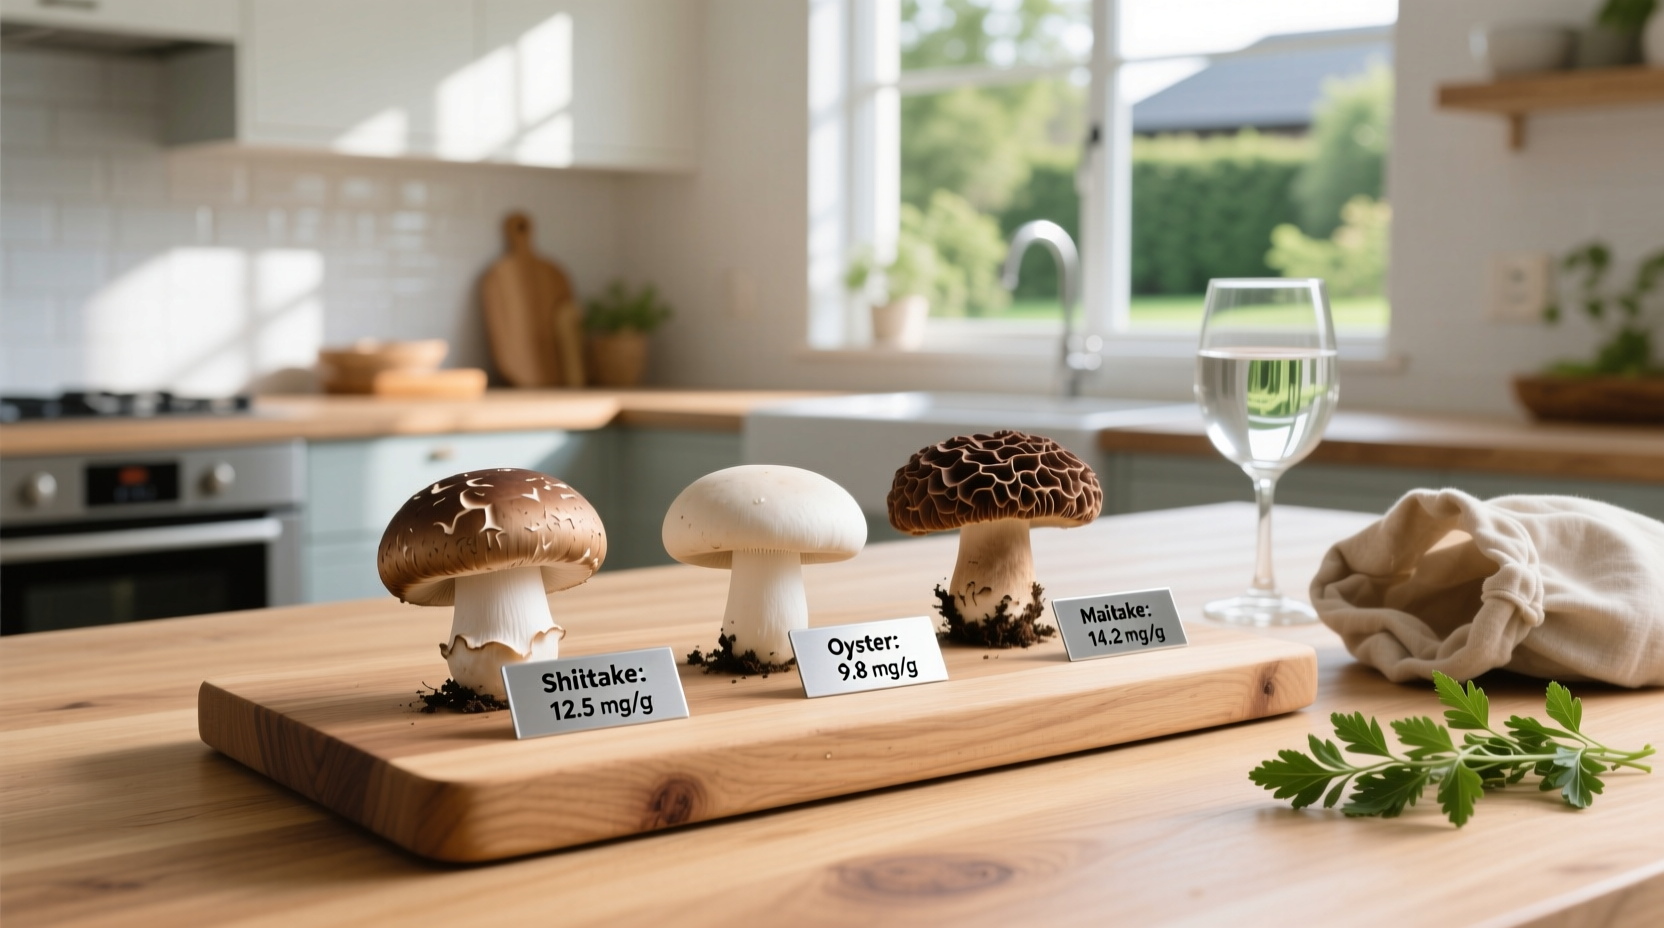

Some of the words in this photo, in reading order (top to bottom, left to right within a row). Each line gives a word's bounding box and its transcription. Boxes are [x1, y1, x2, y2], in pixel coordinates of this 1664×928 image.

[1079, 601, 1152, 625] Maitake:
[827, 635, 900, 661] Oyster:
[1088, 627, 1124, 647] 14.2
[1124, 623, 1166, 646] mg/g
[837, 660, 868, 682] 9.8
[871, 656, 919, 681] mg/g
[549, 696, 595, 721] 12.5
[600, 690, 654, 718] mg/g
